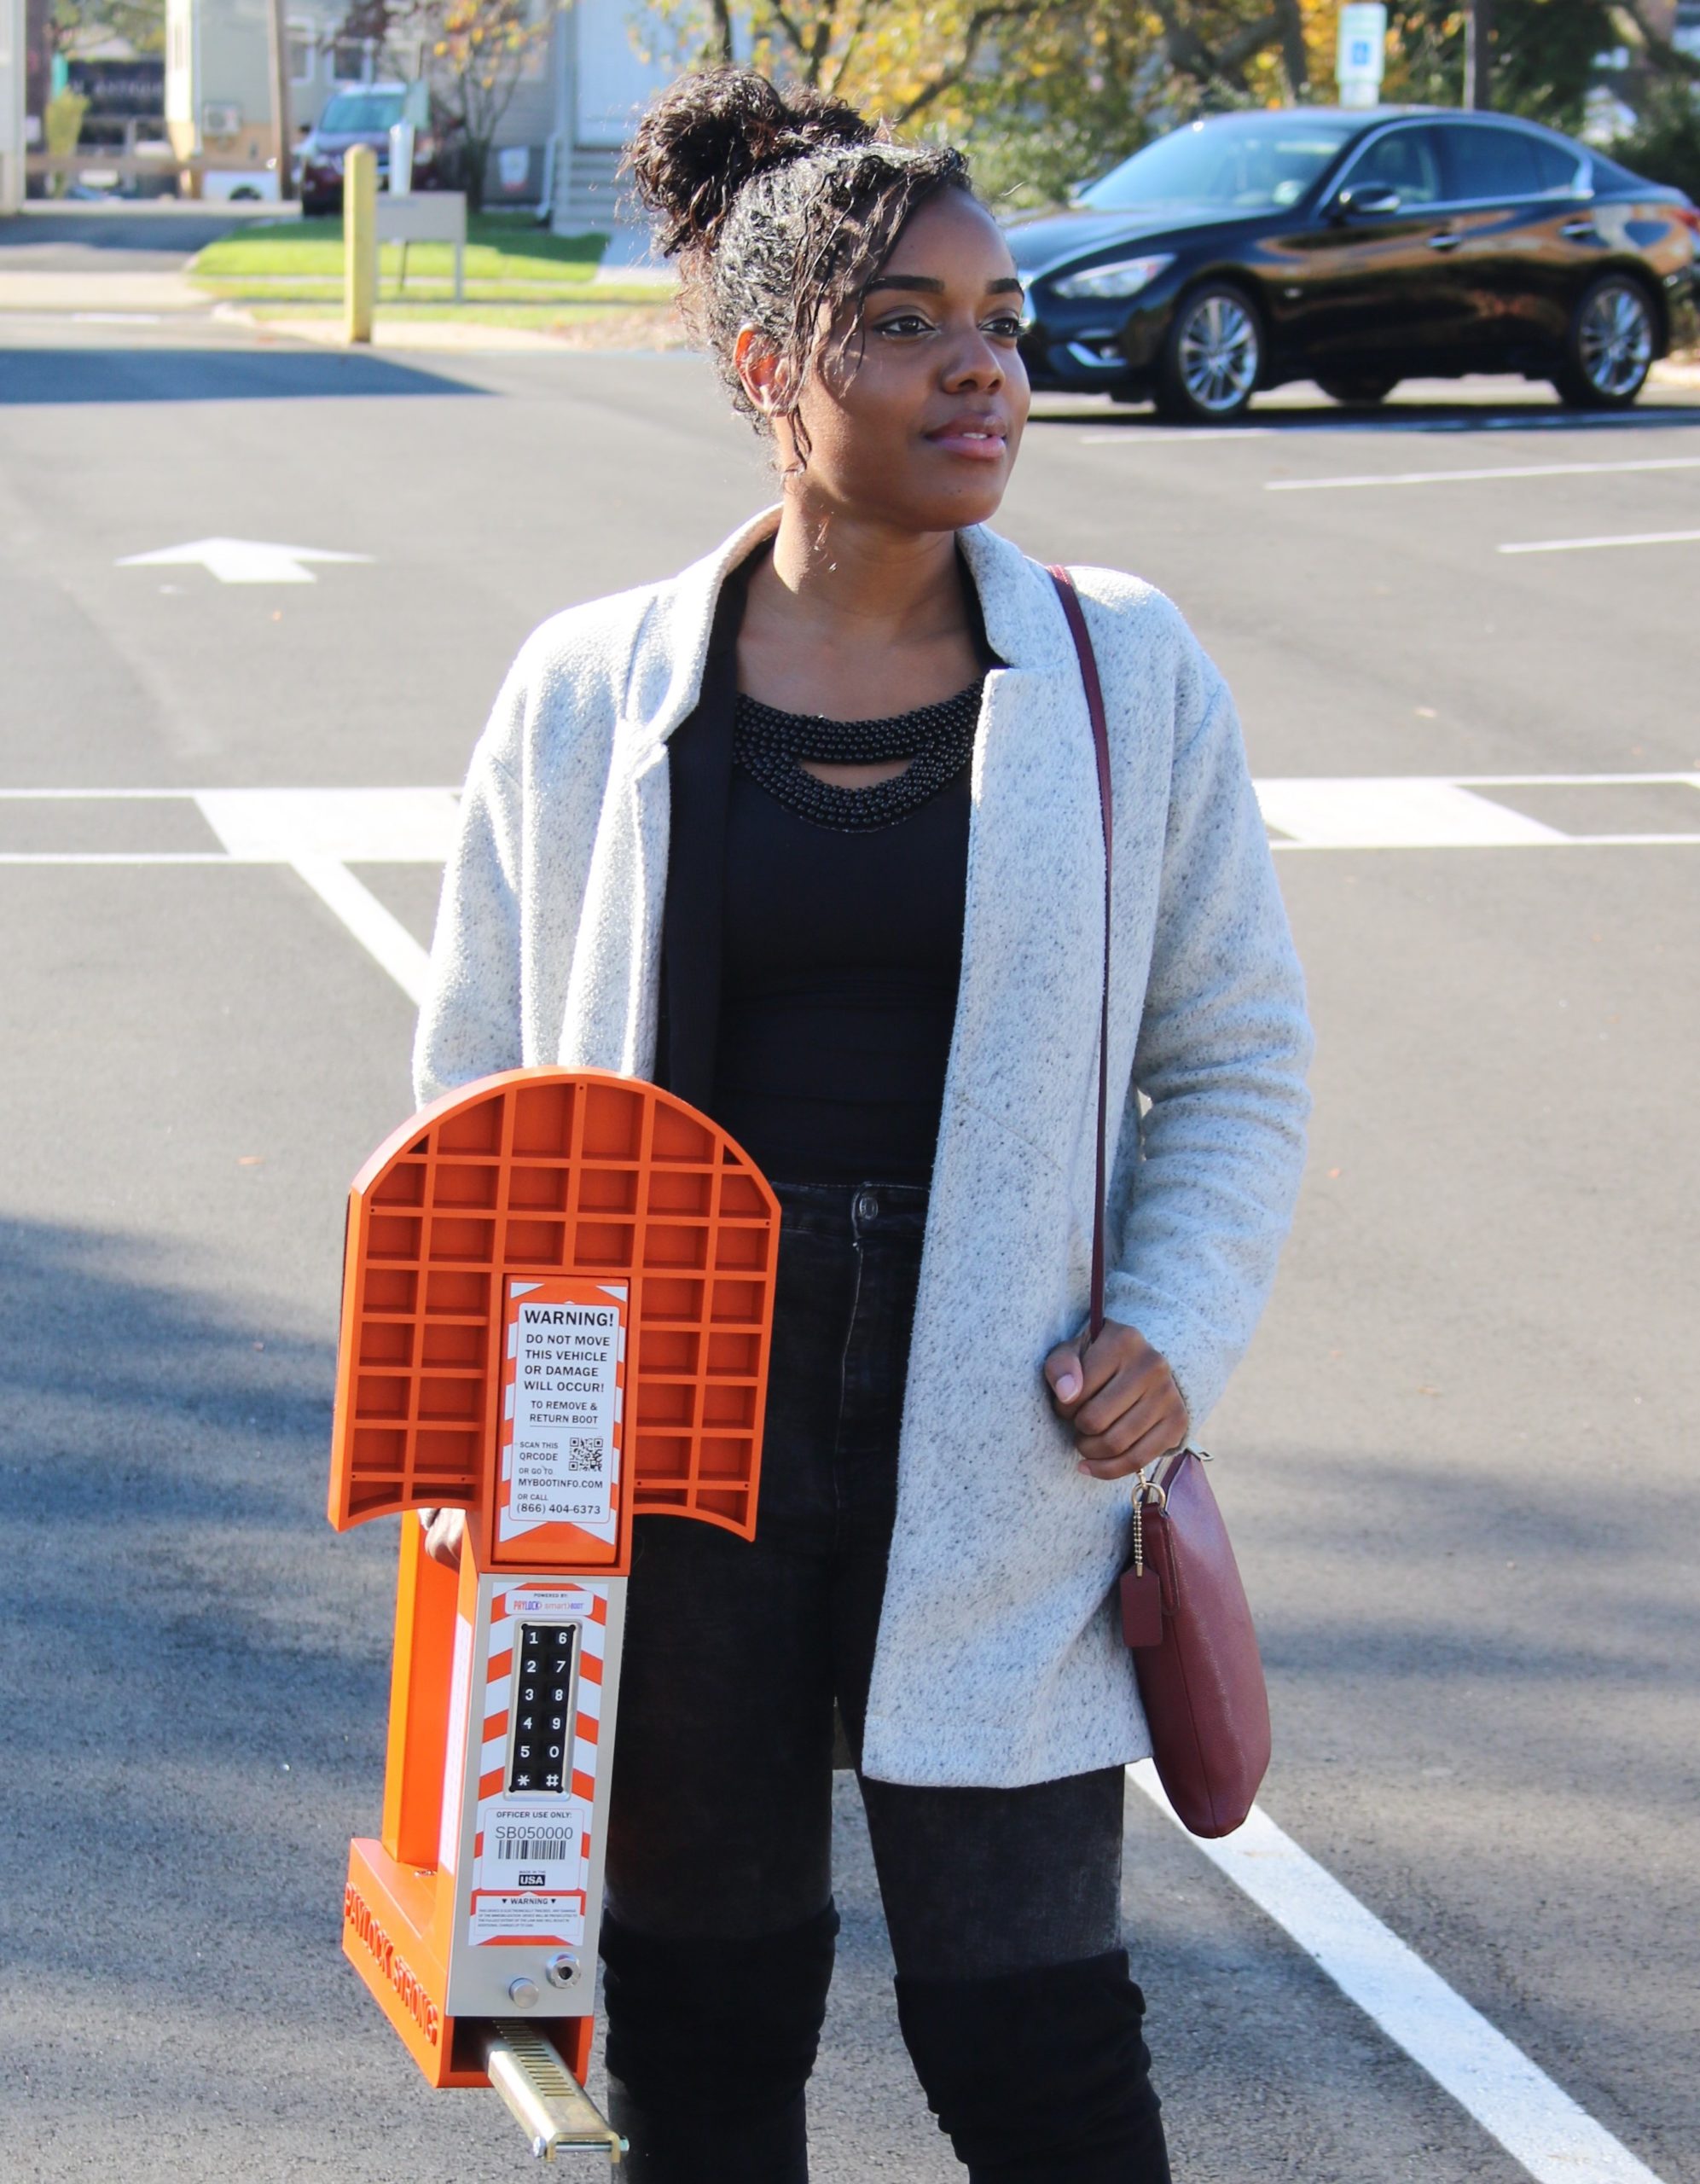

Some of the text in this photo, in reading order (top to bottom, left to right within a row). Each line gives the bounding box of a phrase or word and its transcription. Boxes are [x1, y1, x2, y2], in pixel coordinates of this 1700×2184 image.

[525, 1310, 613, 1327] WARNING!
[526, 1334, 610, 1345] DO NOT MOVE
[525, 1350, 607, 1361] THIS VEHICLE
[525, 1365, 598, 1376] OR DAMAGE
[525, 1381, 604, 1392] WILL OCCUR!
[546, 1401, 587, 1410] REMOVE
[530, 1414, 598, 1424] RETURN BOOT
[519, 1478, 603, 1488] MYBOOTINFO.COM
[517, 1503, 601, 1514] (866) 404-6373
[530, 1632, 566, 1644] 1 6
[527, 1660, 566, 1673] 2 7
[525, 1688, 563, 1701] 3 8
[523, 1717, 560, 1729] 4 9
[520, 1746, 559, 1757] 5 0
[496, 1827, 573, 1839] SB050000
[520, 1876, 543, 1885] USA
[345, 1881, 438, 2046] PAYLOCK STRONG
